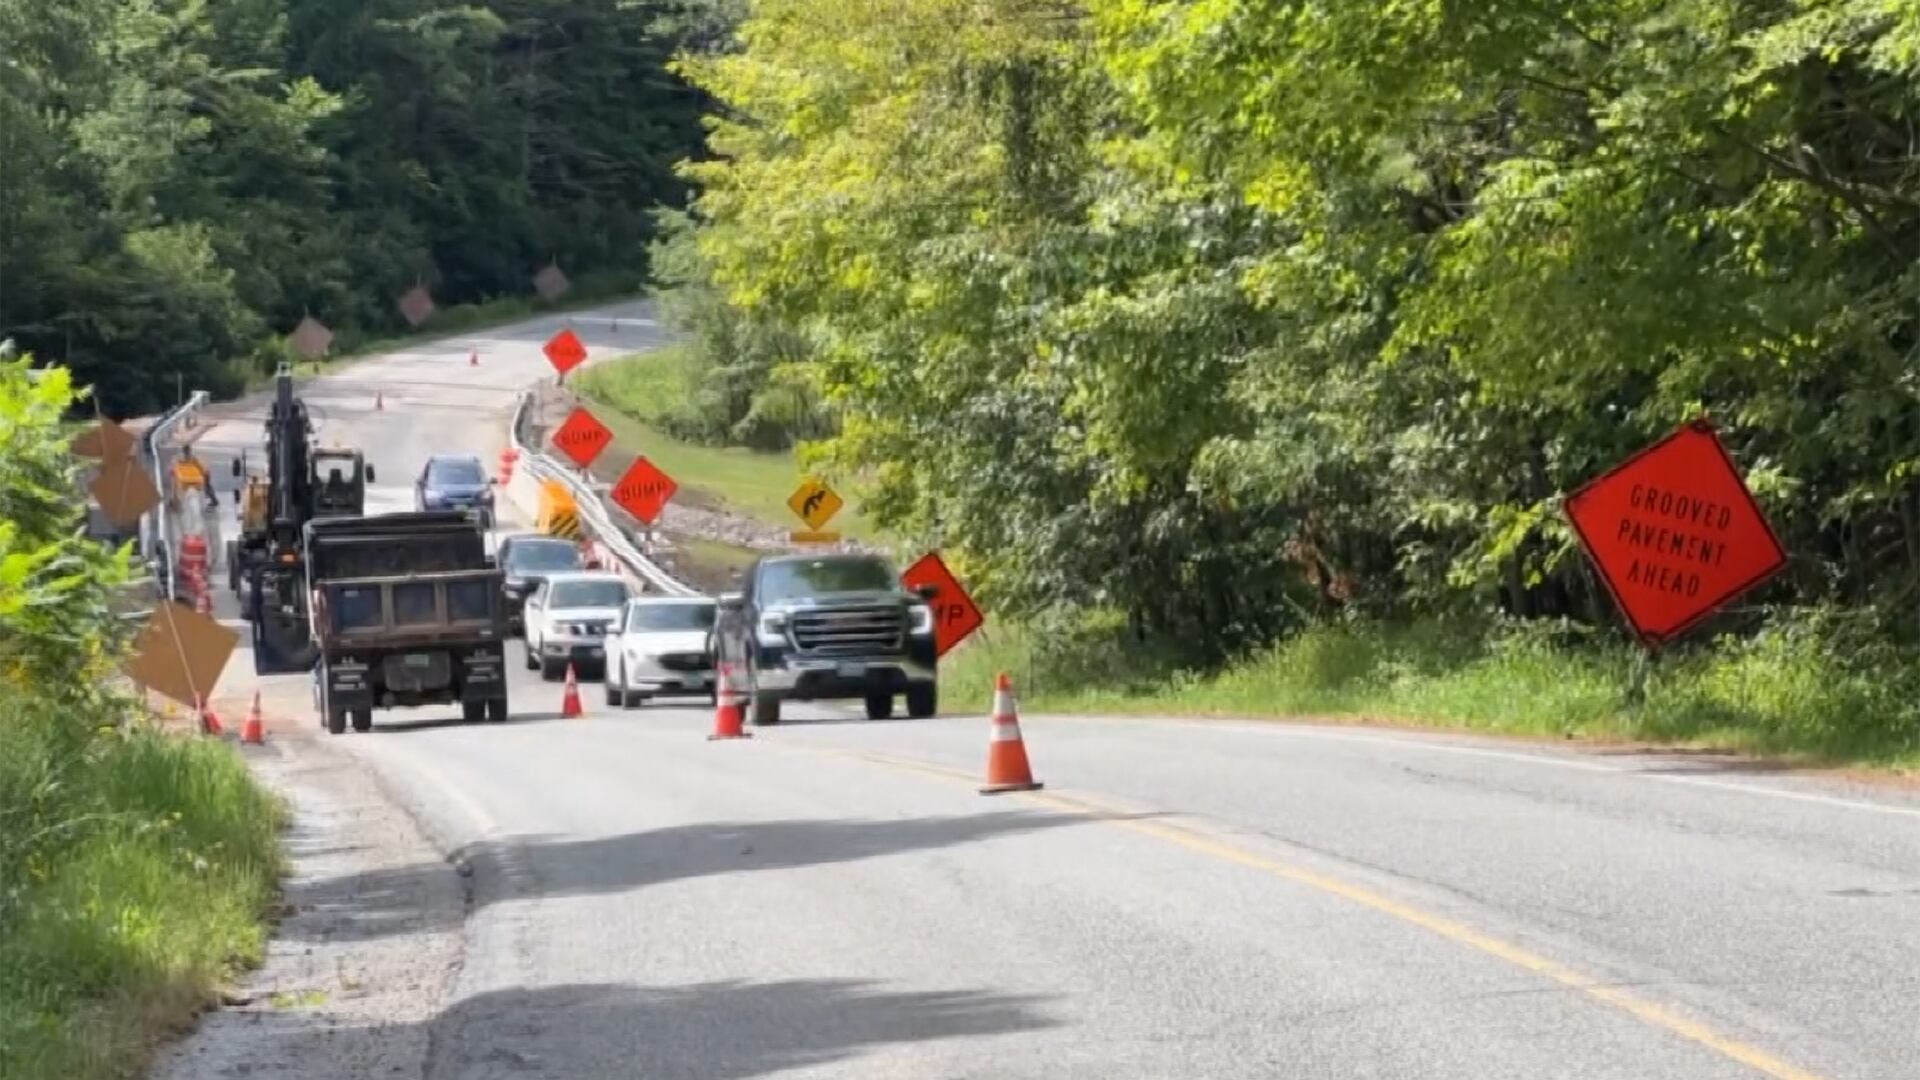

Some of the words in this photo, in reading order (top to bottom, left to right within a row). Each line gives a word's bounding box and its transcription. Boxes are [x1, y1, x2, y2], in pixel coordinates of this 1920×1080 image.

[1630, 483, 1731, 530] GROOVED
[1617, 518, 1729, 569] PAVEMENT
[1626, 559, 1701, 598] AHEAD
